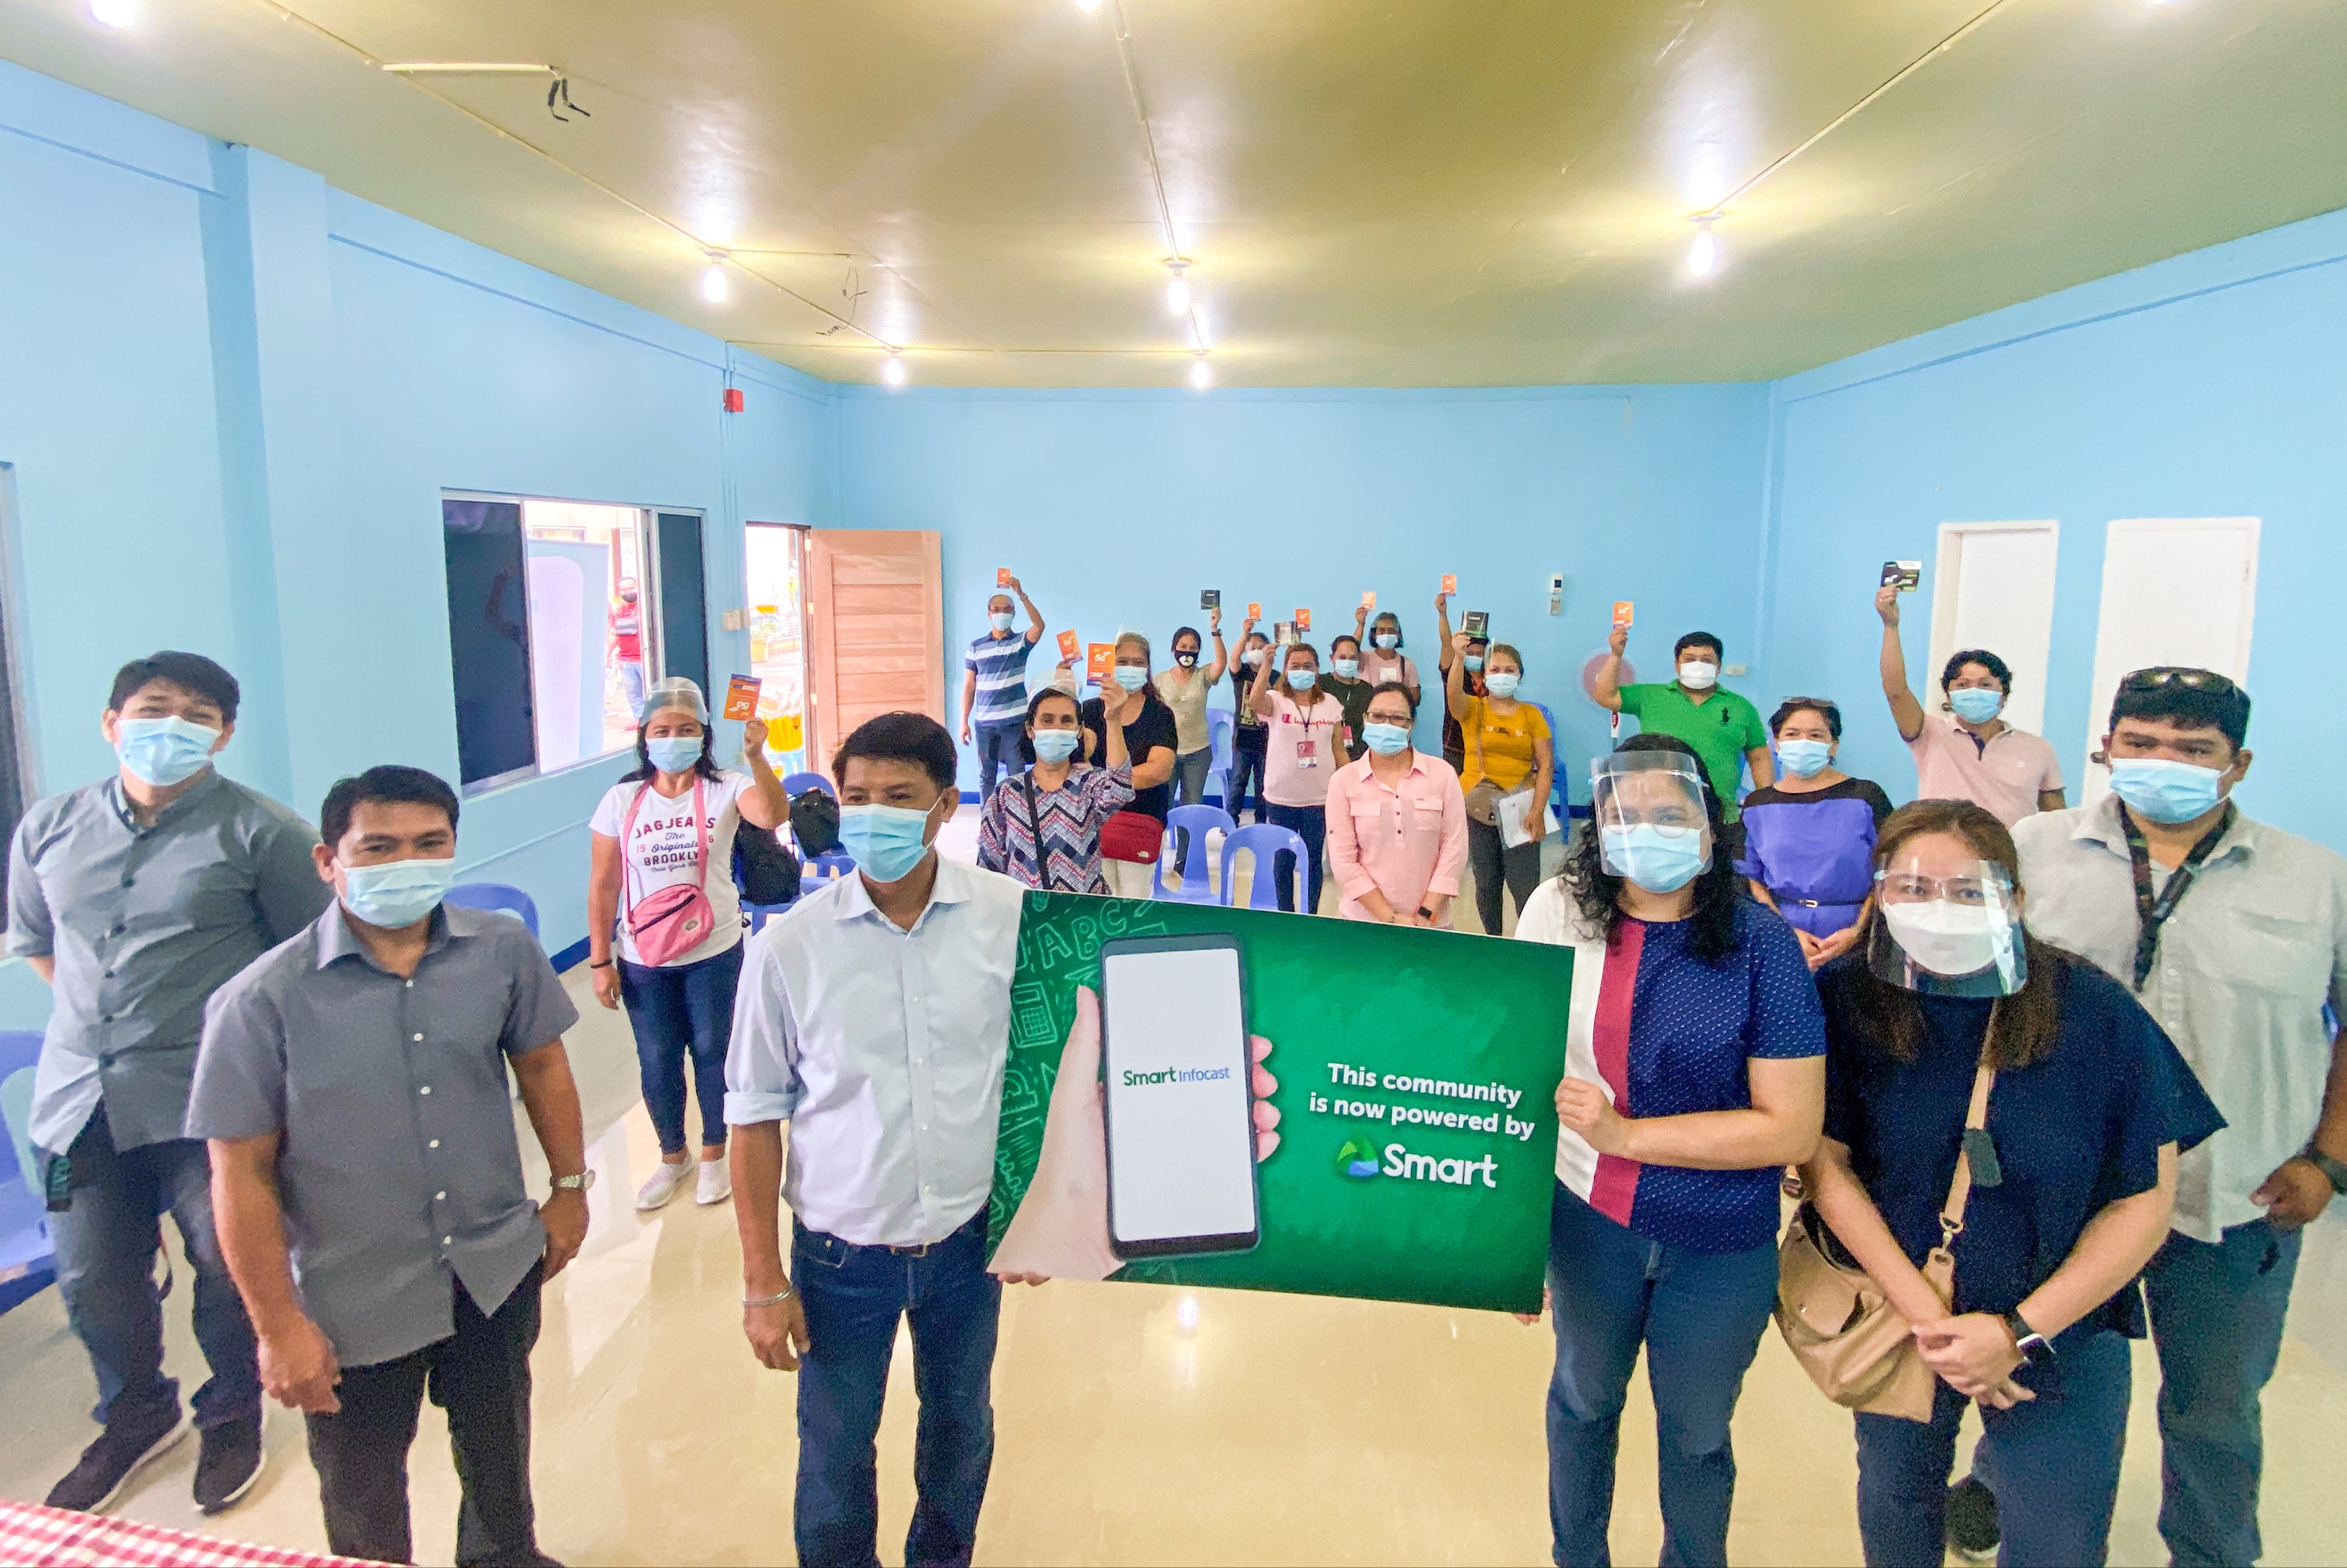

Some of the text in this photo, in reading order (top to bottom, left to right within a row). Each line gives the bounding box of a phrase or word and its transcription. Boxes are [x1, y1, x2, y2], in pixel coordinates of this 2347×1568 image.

[665, 817, 716, 829] JEAS
[665, 832, 685, 840] The
[644, 849, 709, 866] BROOKLY
[1122, 1066, 1230, 1086] Smart Infocast
[1327, 1062, 1522, 1109] This community
[1309, 1092, 1536, 1142] is now powered by
[1383, 1143, 1499, 1188] Smart
